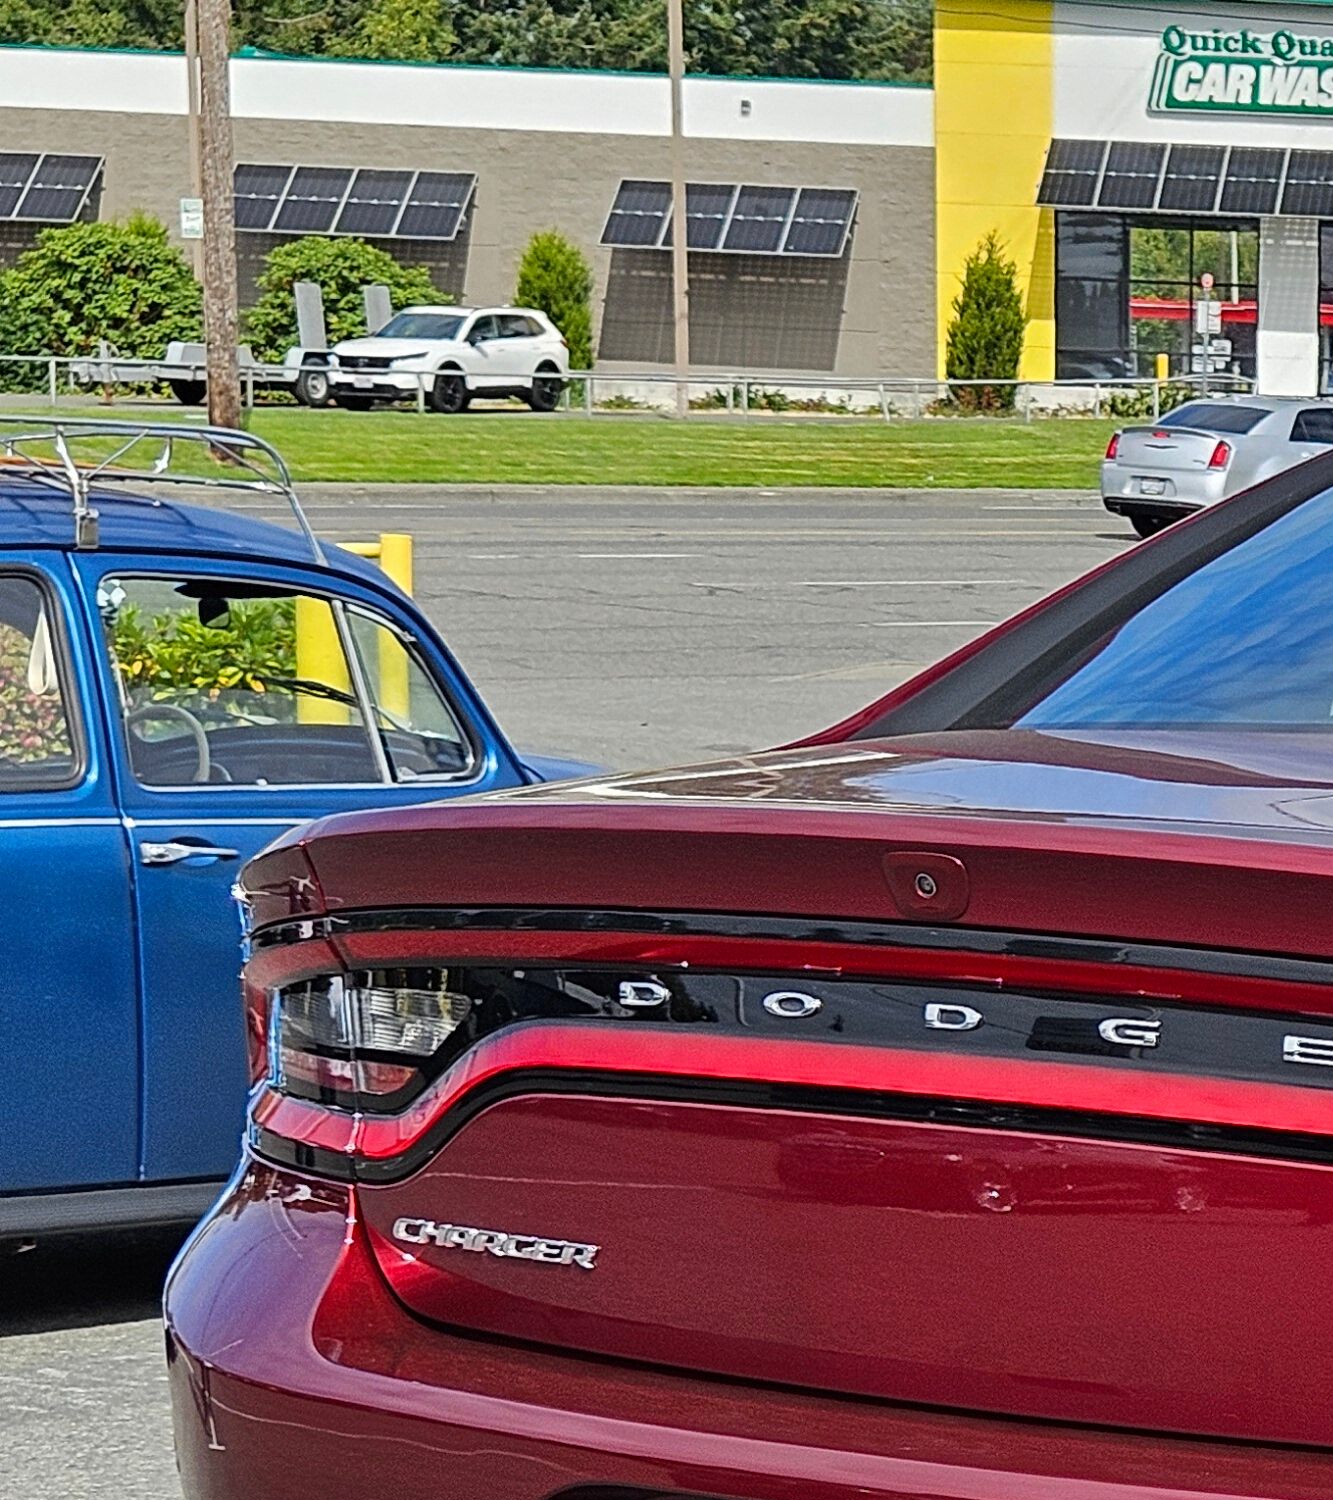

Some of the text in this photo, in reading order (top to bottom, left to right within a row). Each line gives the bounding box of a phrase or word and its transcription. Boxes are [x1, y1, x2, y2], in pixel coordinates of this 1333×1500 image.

[1163, 24, 1263, 56] Quick
[1172, 62, 1257, 104] CAR
[391, 1216, 601, 1269] CHARGER
